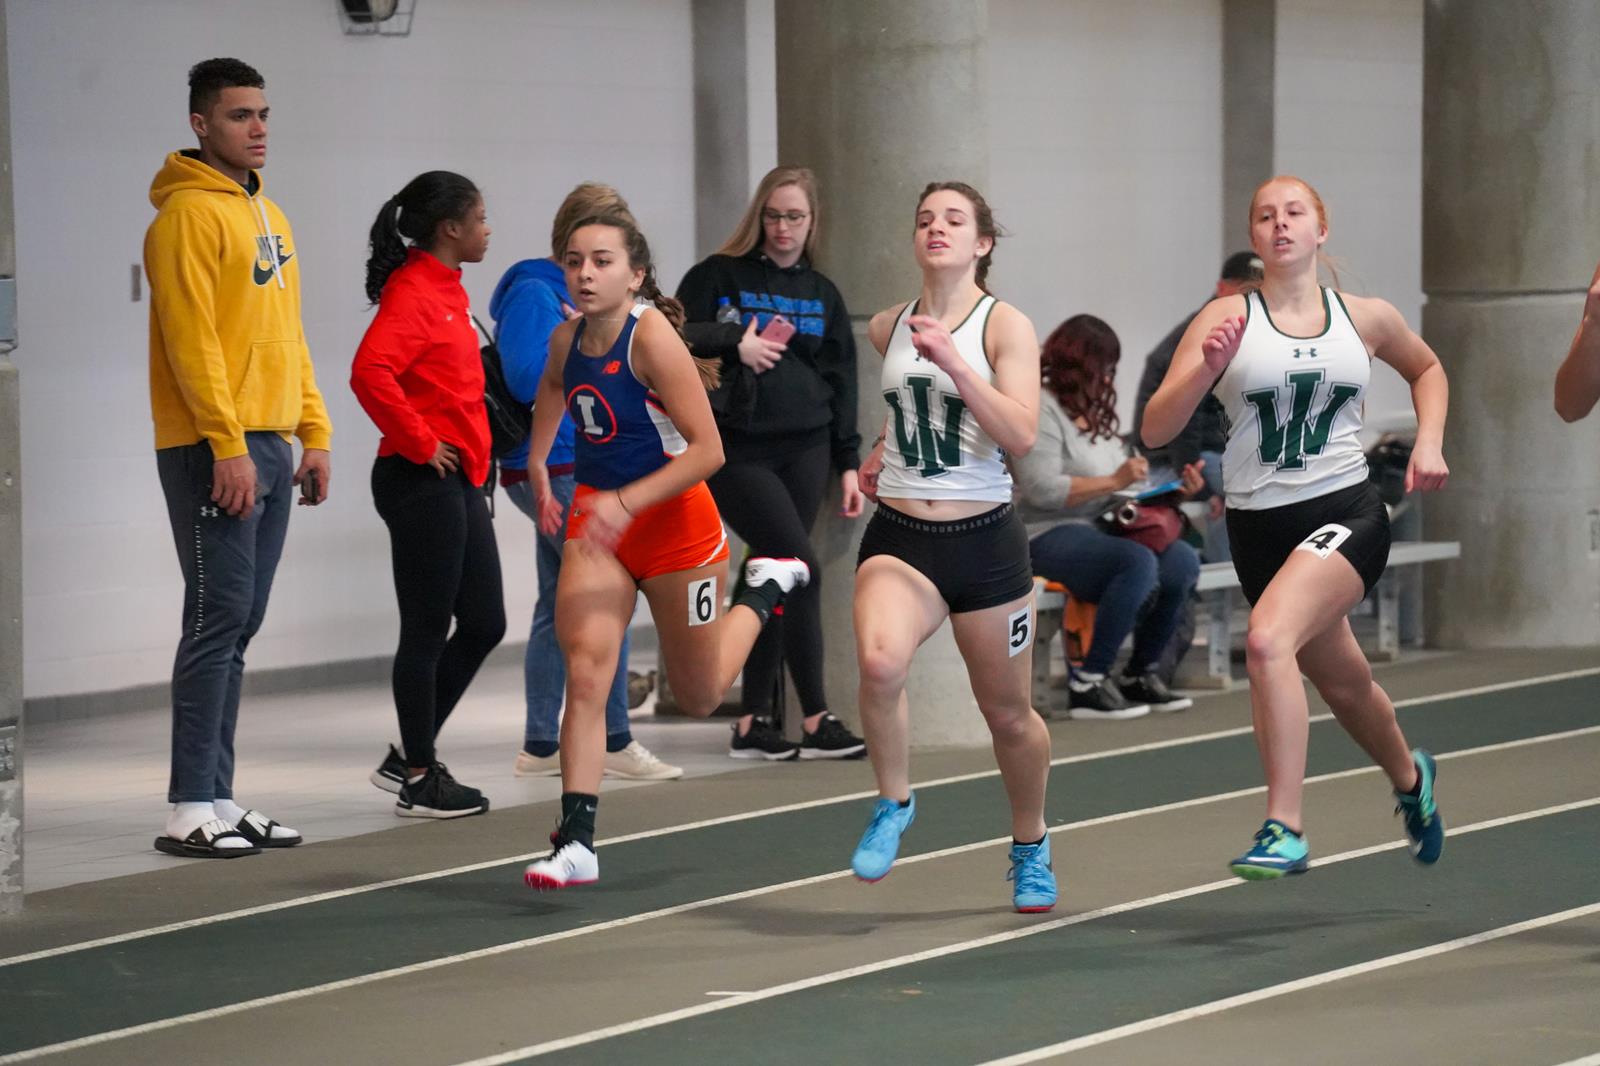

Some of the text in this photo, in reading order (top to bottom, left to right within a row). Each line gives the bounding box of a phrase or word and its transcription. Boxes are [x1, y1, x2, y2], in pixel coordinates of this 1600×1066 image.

[576, 394, 604, 436] I
[1305, 530, 1338, 551] 4
[696, 581, 712, 622] 6
[1011, 612, 1028, 648] 5
